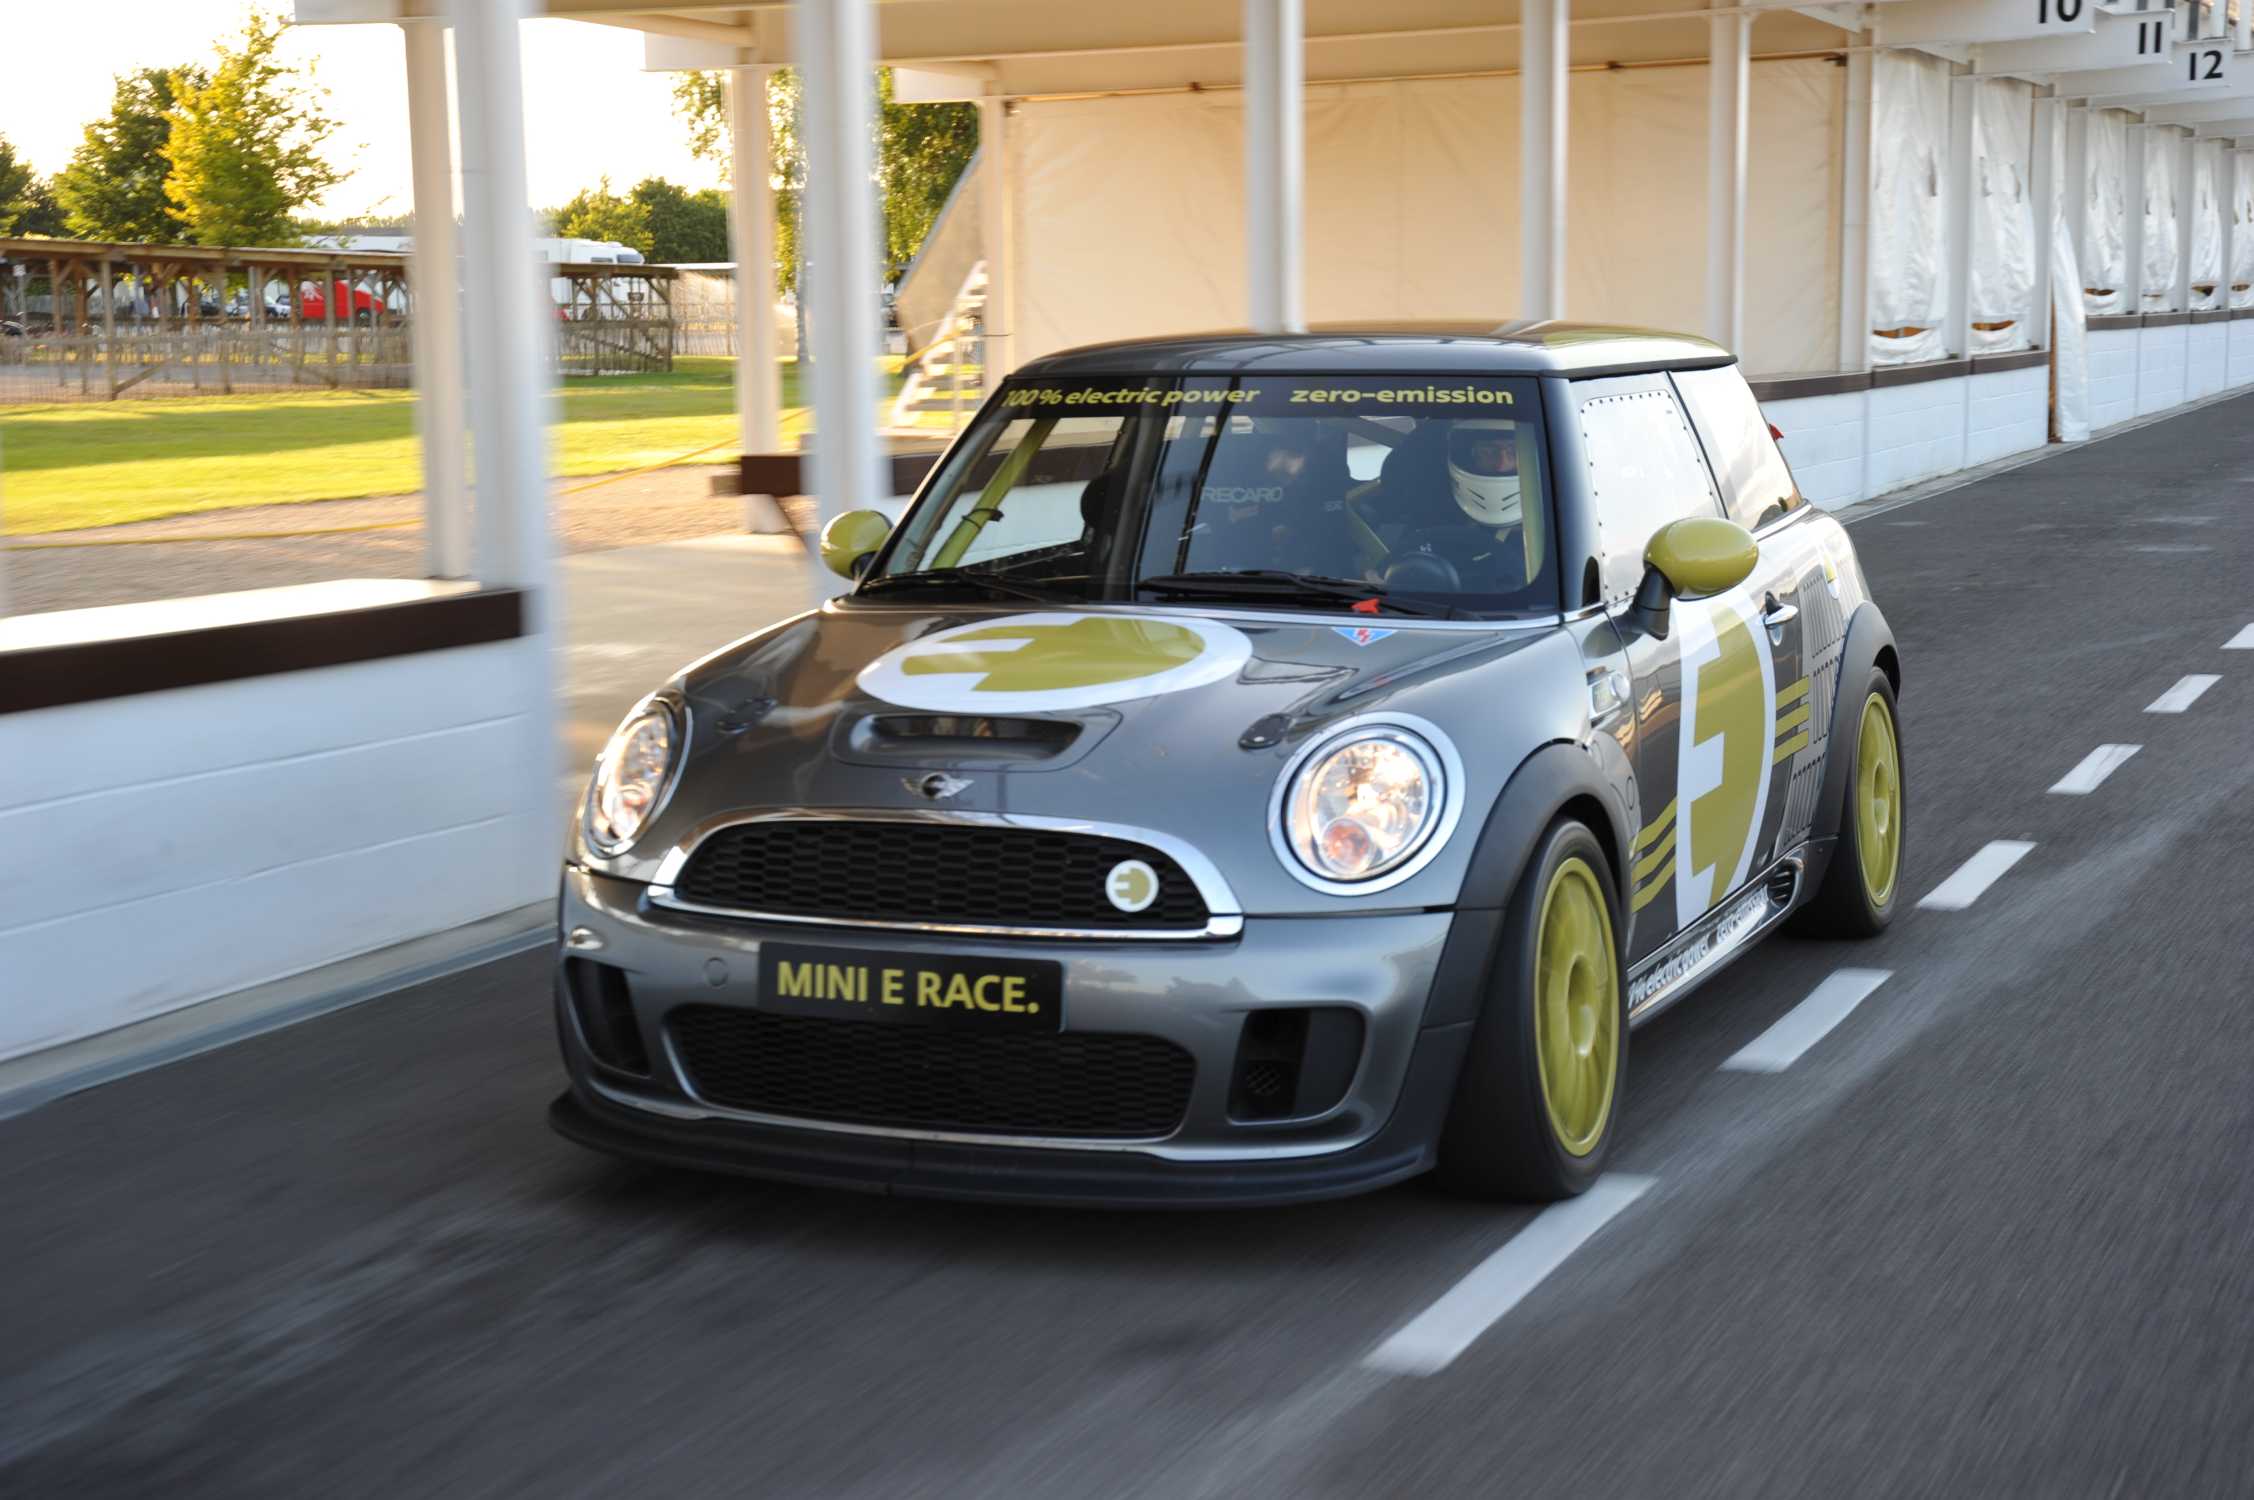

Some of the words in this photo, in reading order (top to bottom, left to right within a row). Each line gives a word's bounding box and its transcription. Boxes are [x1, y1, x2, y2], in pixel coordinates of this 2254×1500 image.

[2138, 21, 2163, 54] 11
[2188, 50, 2224, 80] 12
[1065, 387, 1162, 405] electric
[1161, 389, 1261, 407] power
[1290, 386, 1514, 405] zero-emission
[1201, 486, 1283, 503] RECARO
[777, 960, 868, 1002] MINI
[882, 968, 905, 1005] E
[917, 971, 1040, 1014] RACE.
